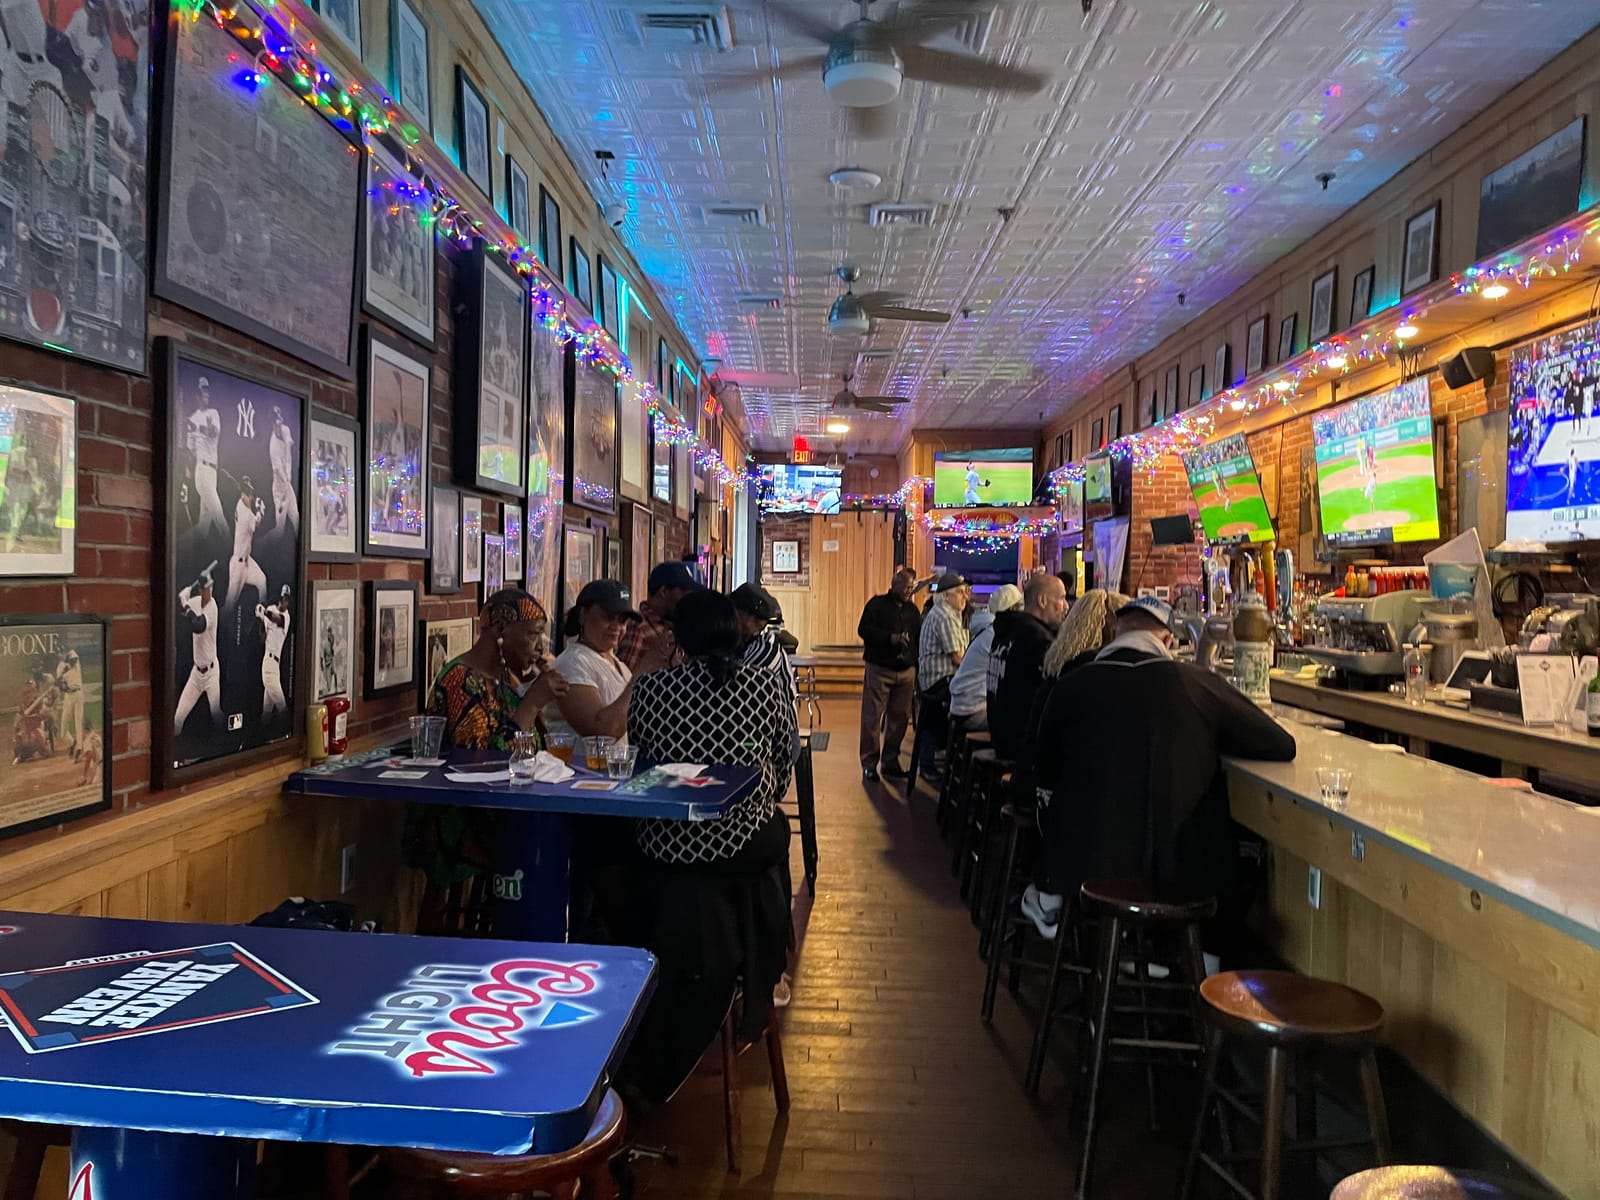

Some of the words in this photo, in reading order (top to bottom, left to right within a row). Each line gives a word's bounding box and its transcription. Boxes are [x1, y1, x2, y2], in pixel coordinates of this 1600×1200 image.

[794, 450, 809, 463] EXIT
[38, 961, 195, 1025] TAVERN
[88, 963, 240, 1029] YANKEE
[334, 965, 483, 1058] LIGHT
[405, 960, 600, 1078] Coors
